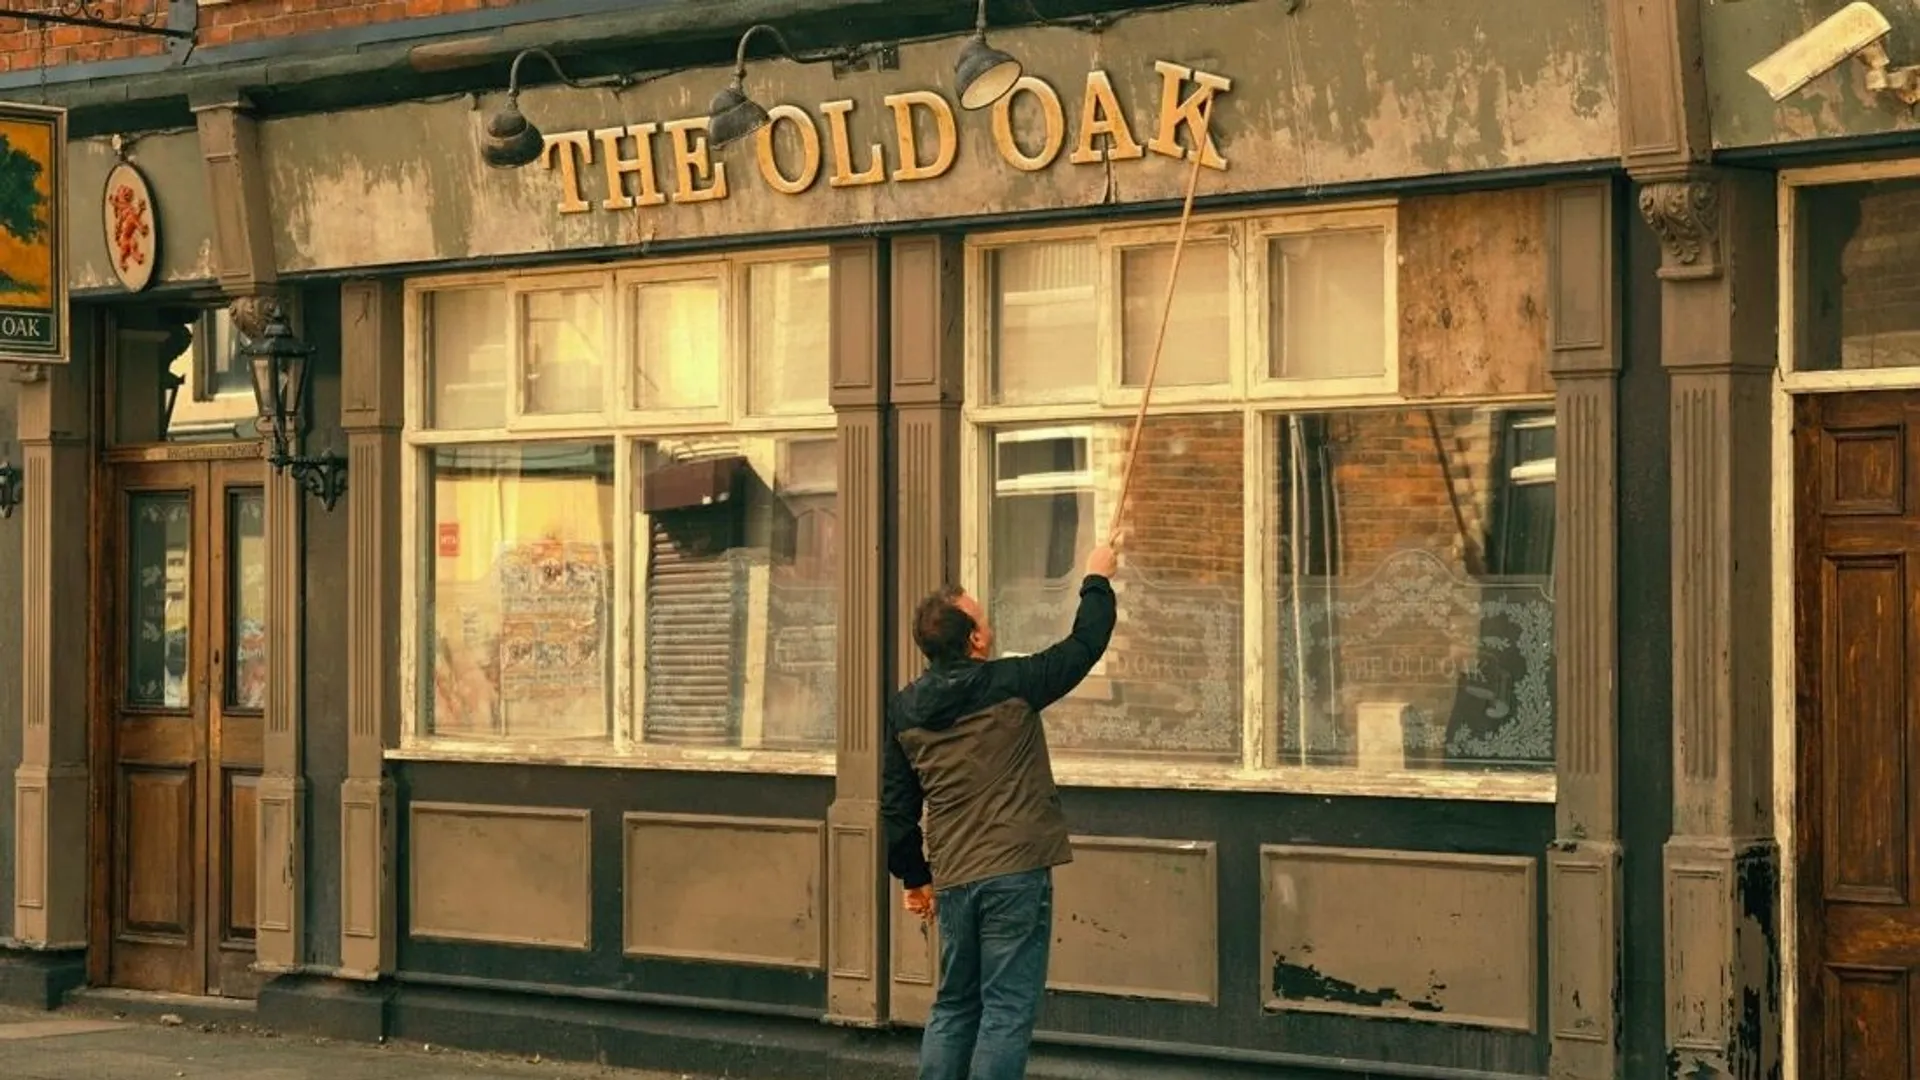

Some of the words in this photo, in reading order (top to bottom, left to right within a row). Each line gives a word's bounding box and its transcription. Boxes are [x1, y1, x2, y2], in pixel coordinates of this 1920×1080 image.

[541, 114, 728, 213] THE
[754, 90, 958, 195] OLD
[991, 59, 1232, 172] OAK
[2, 316, 40, 337] OAK
